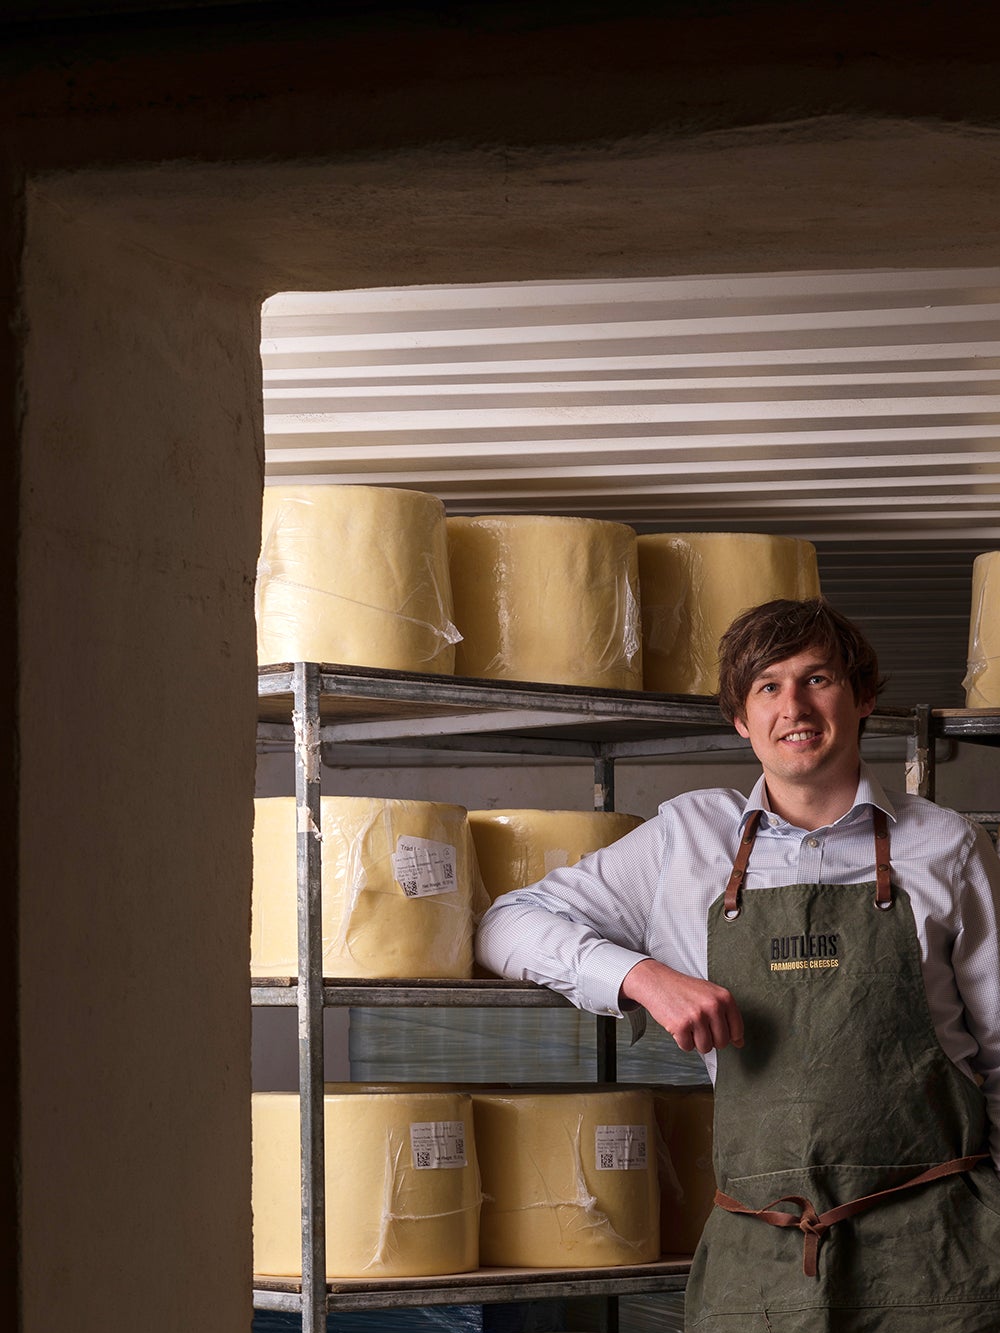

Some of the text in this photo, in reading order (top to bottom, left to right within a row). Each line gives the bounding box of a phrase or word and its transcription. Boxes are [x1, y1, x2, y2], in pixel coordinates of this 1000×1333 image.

[771, 935, 837, 960] BUTLERS
[770, 959, 839, 971] FARMHOUSE CHEESES
